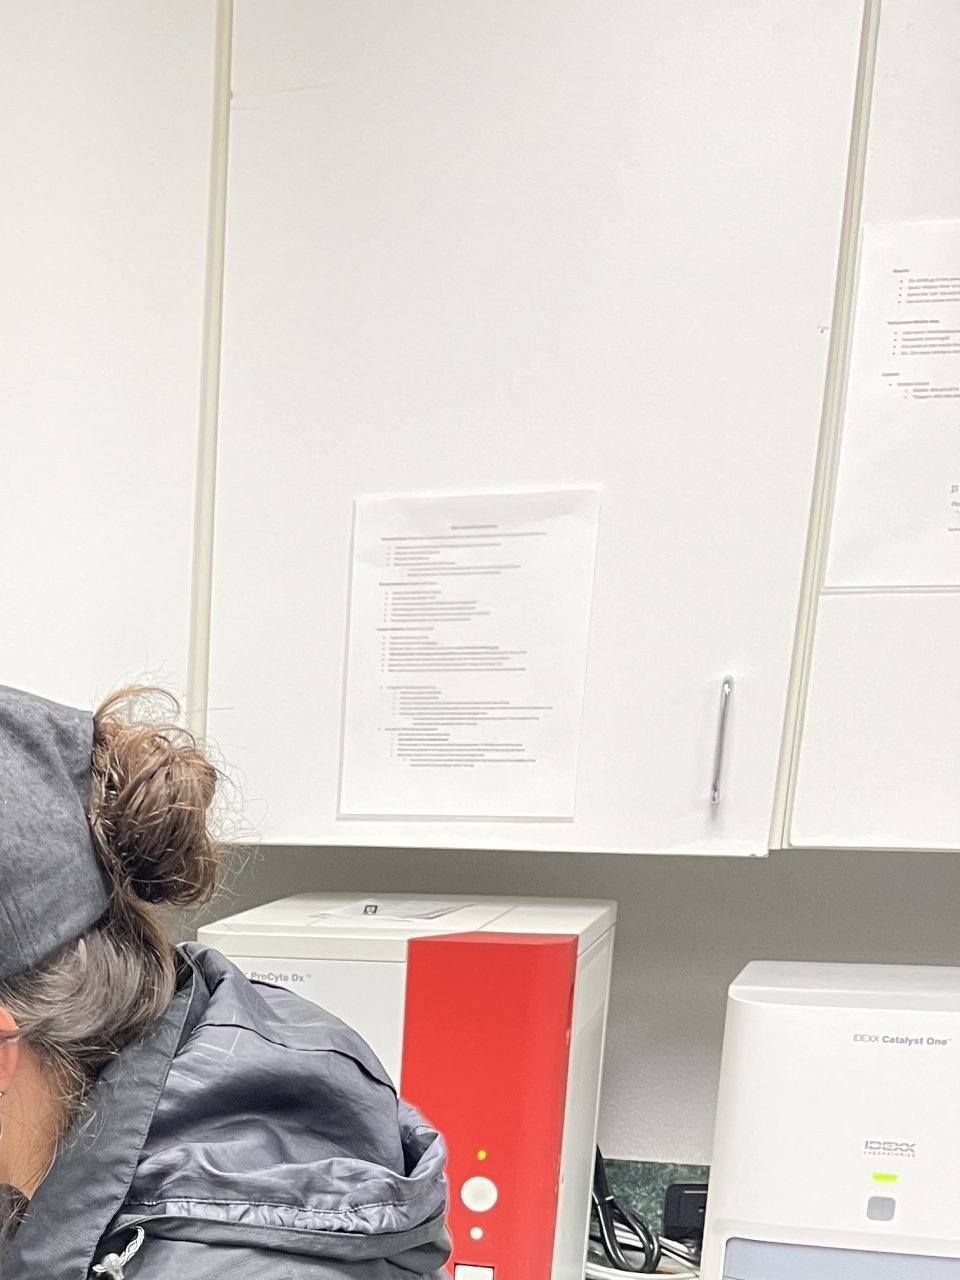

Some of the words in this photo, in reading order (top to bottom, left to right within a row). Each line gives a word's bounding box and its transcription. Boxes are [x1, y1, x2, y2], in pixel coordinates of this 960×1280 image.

[250, 972, 290, 983] ProCyte
[853, 1034, 880, 1043] IDEXX
[882, 1035, 924, 1046] Catalyst
[926, 1037, 948, 1046] One
[864, 1140, 916, 1153] IDEXX
